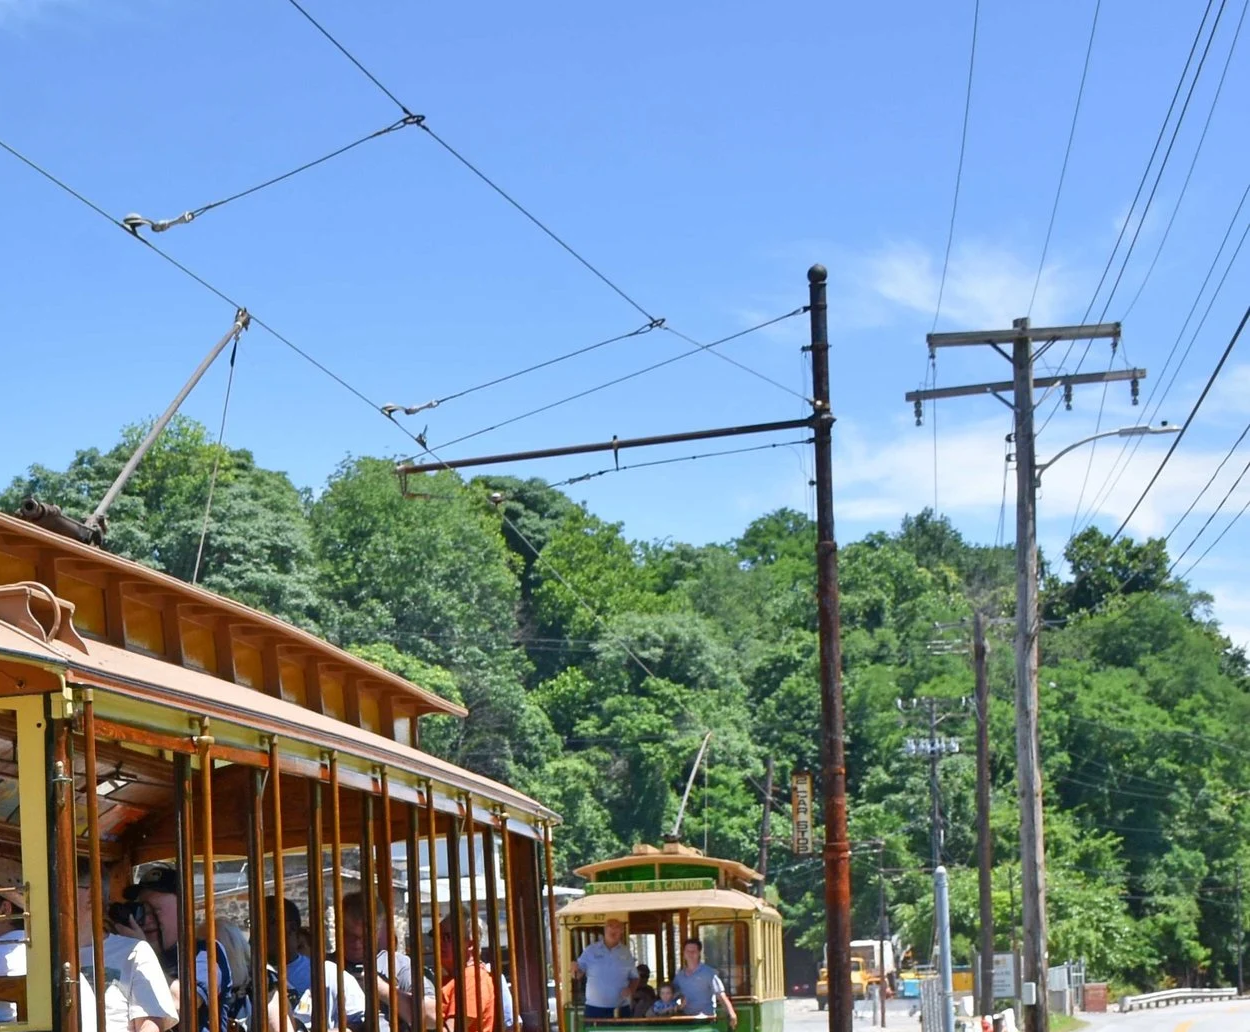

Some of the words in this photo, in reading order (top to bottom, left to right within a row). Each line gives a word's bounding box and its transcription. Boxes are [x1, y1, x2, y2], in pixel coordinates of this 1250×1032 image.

[796, 790, 808, 814] CAR
[796, 821, 809, 852] STOP
[665, 879, 703, 890] CANTON
